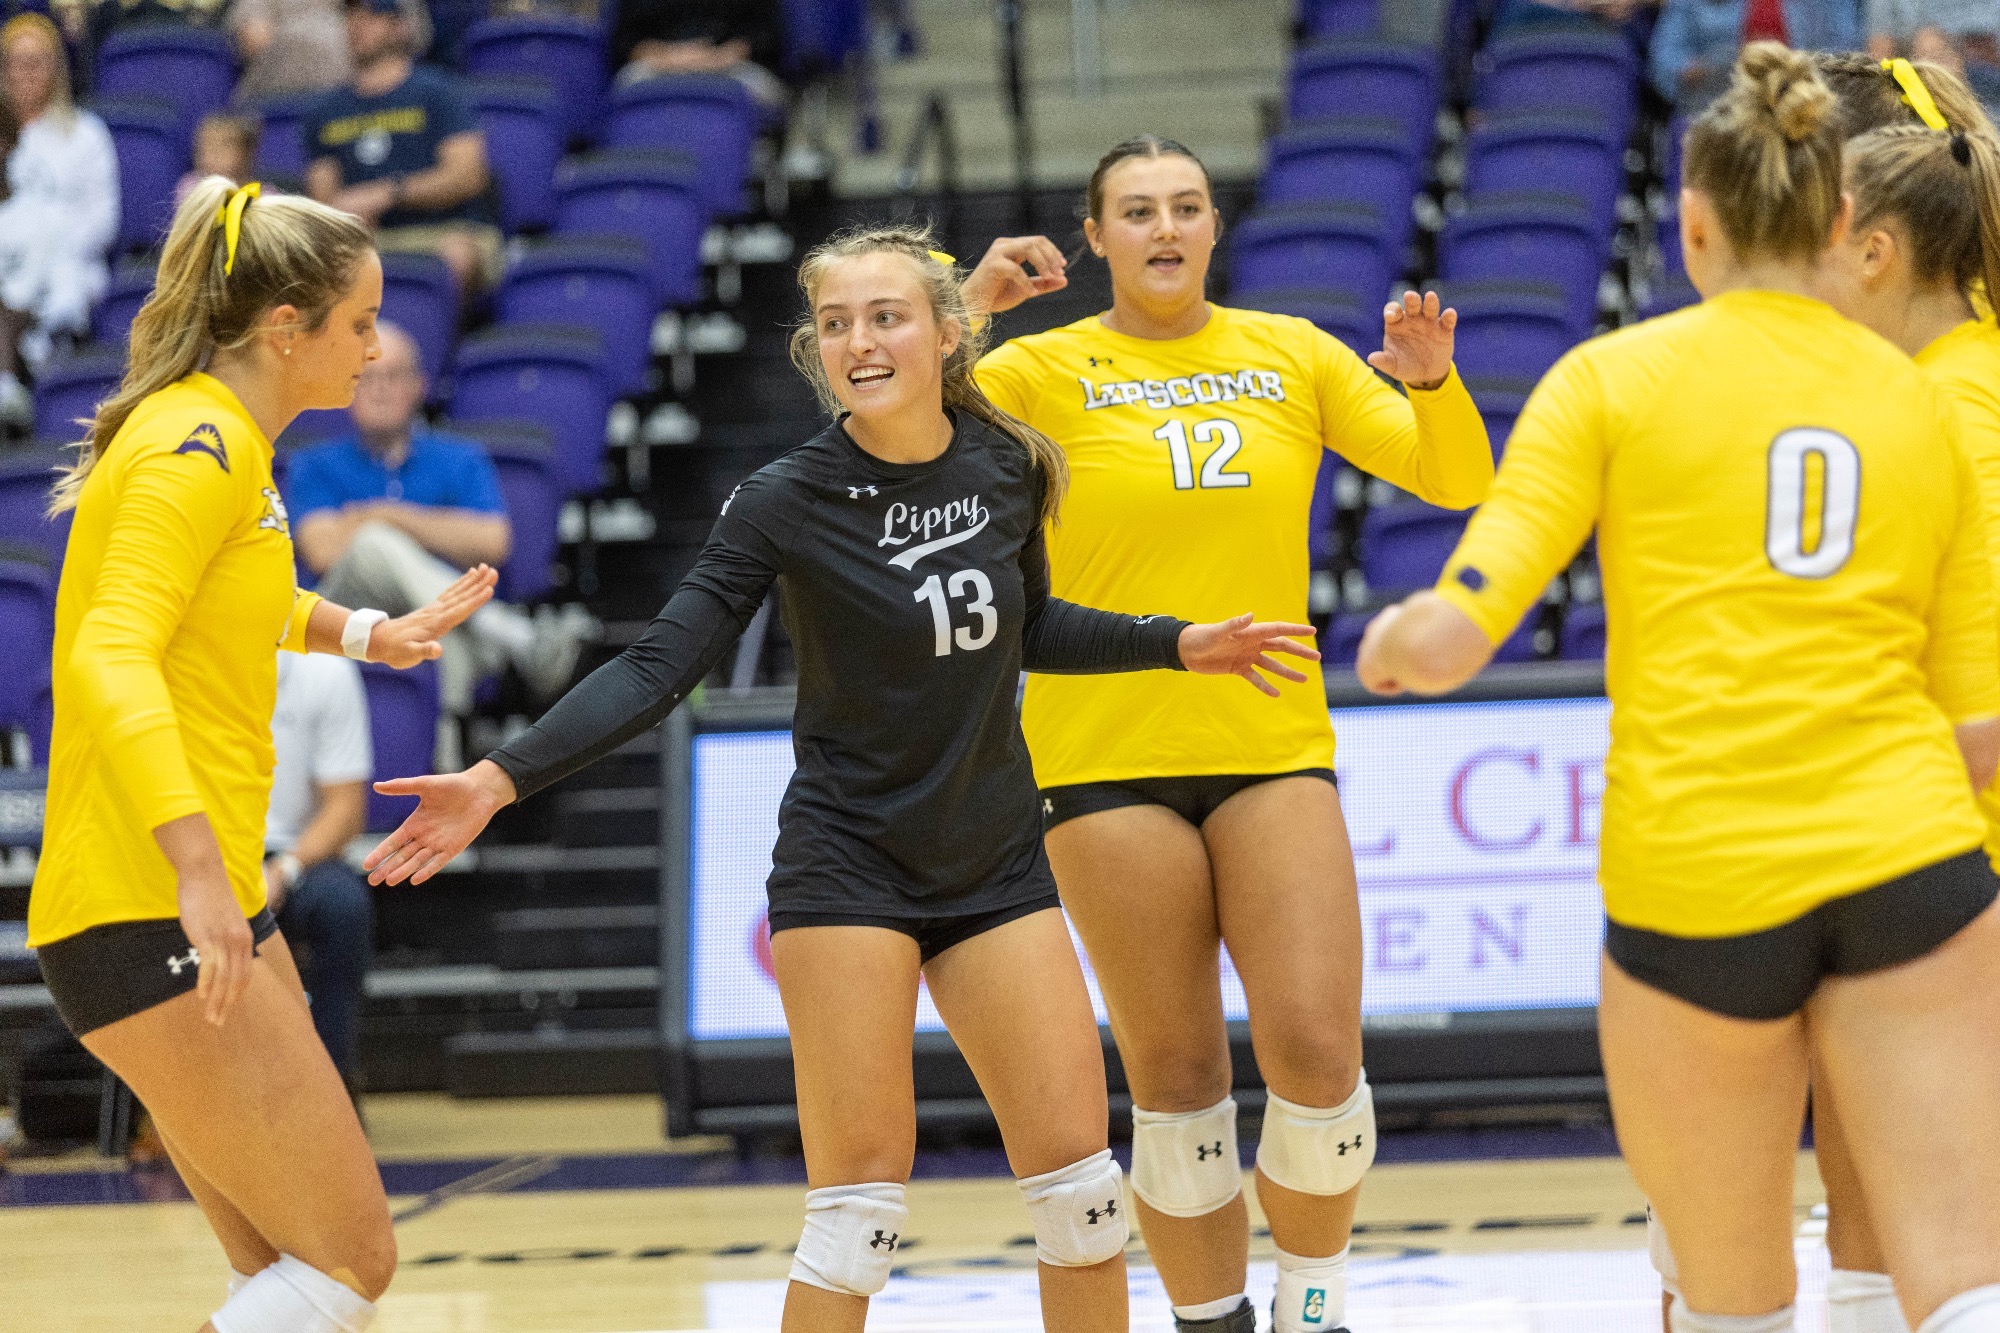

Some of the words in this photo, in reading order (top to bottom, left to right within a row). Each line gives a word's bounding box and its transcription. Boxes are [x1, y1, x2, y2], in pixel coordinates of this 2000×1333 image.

[1078, 369, 1286, 411] LIPSCOMB
[1153, 417, 1250, 490] 12
[877, 495, 989, 547] Lippy
[1765, 425, 1862, 580] 0
[913, 568, 997, 657] 13
